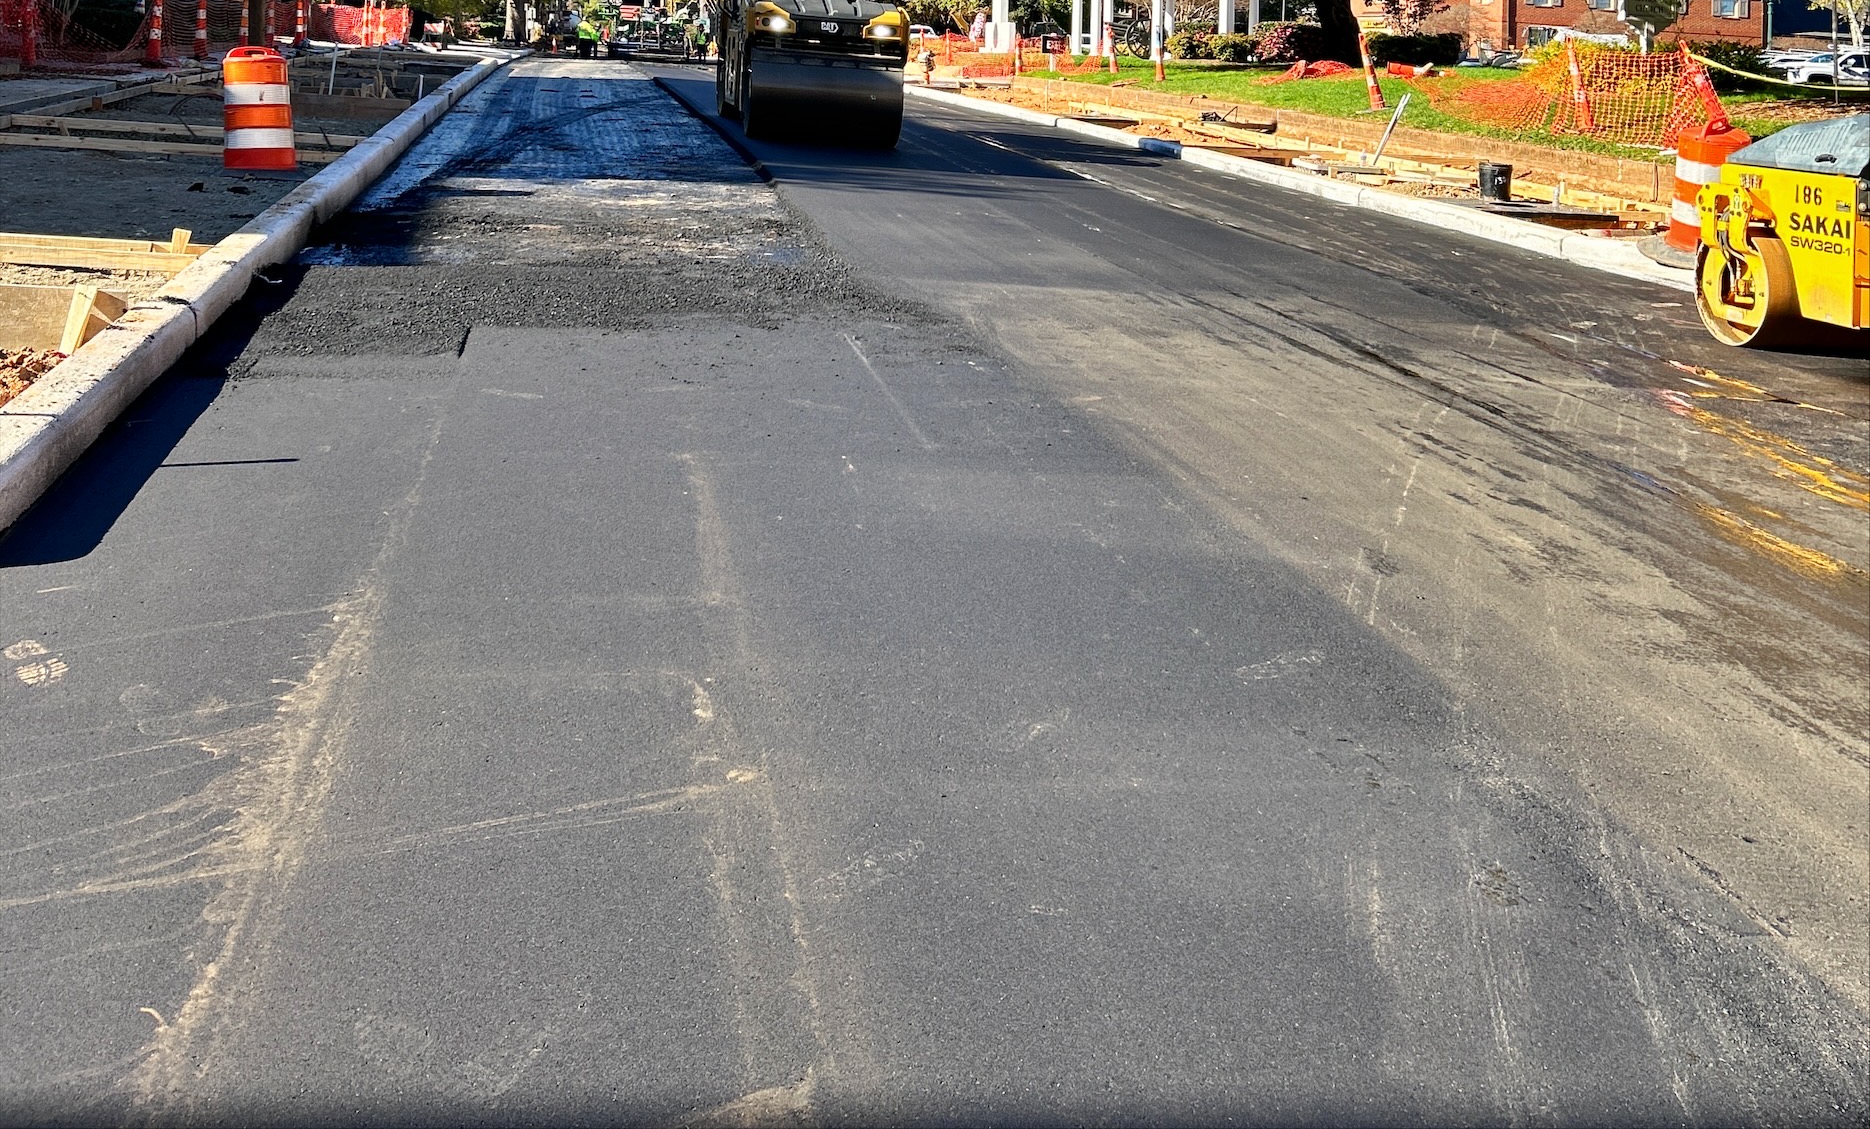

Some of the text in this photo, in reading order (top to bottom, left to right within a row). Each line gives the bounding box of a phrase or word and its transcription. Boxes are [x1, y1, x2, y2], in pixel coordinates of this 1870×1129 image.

[1795, 184, 1823, 206] 186
[1789, 212, 1851, 240] SAKAI
[1790, 236, 1851, 257] SW320-1
